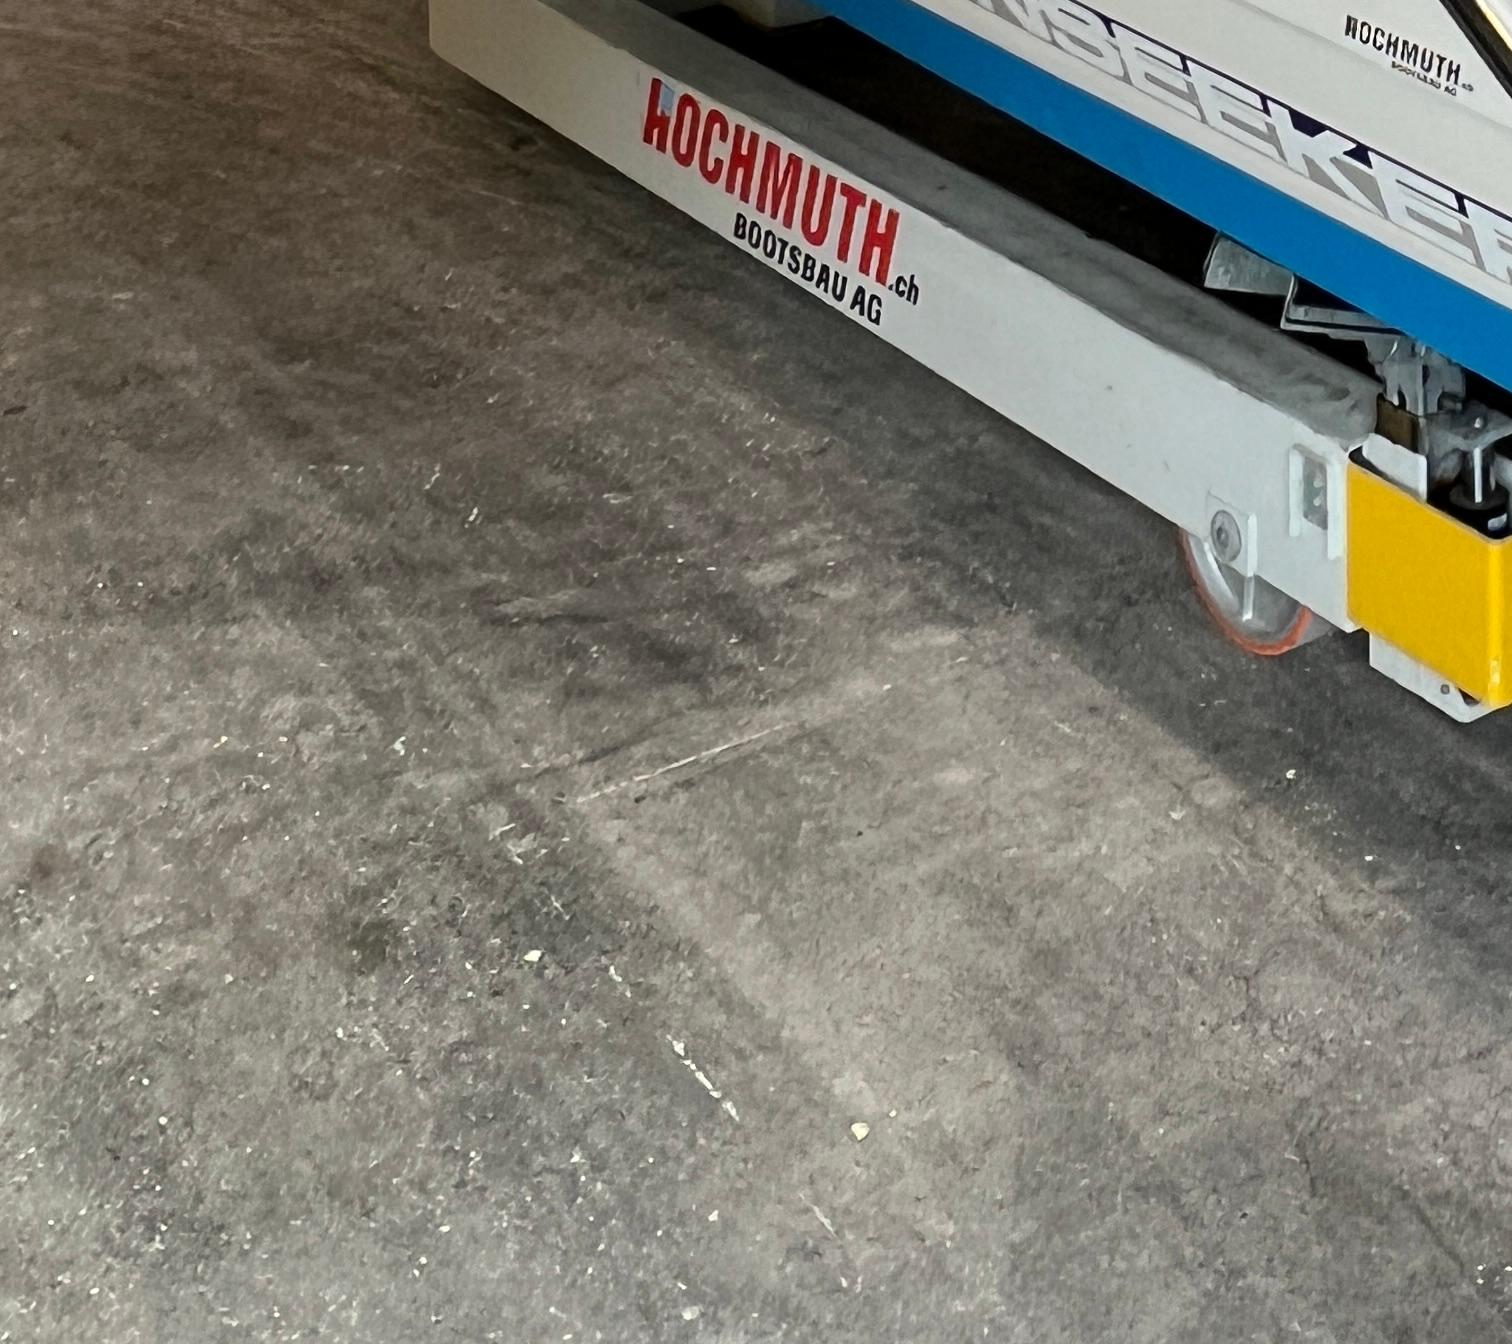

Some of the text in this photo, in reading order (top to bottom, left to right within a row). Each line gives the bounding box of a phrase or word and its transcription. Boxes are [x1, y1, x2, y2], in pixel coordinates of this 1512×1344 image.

[642, 77, 920, 306] HOCHMUTH.ch
[733, 212, 883, 326] BOOTSBAU AG
